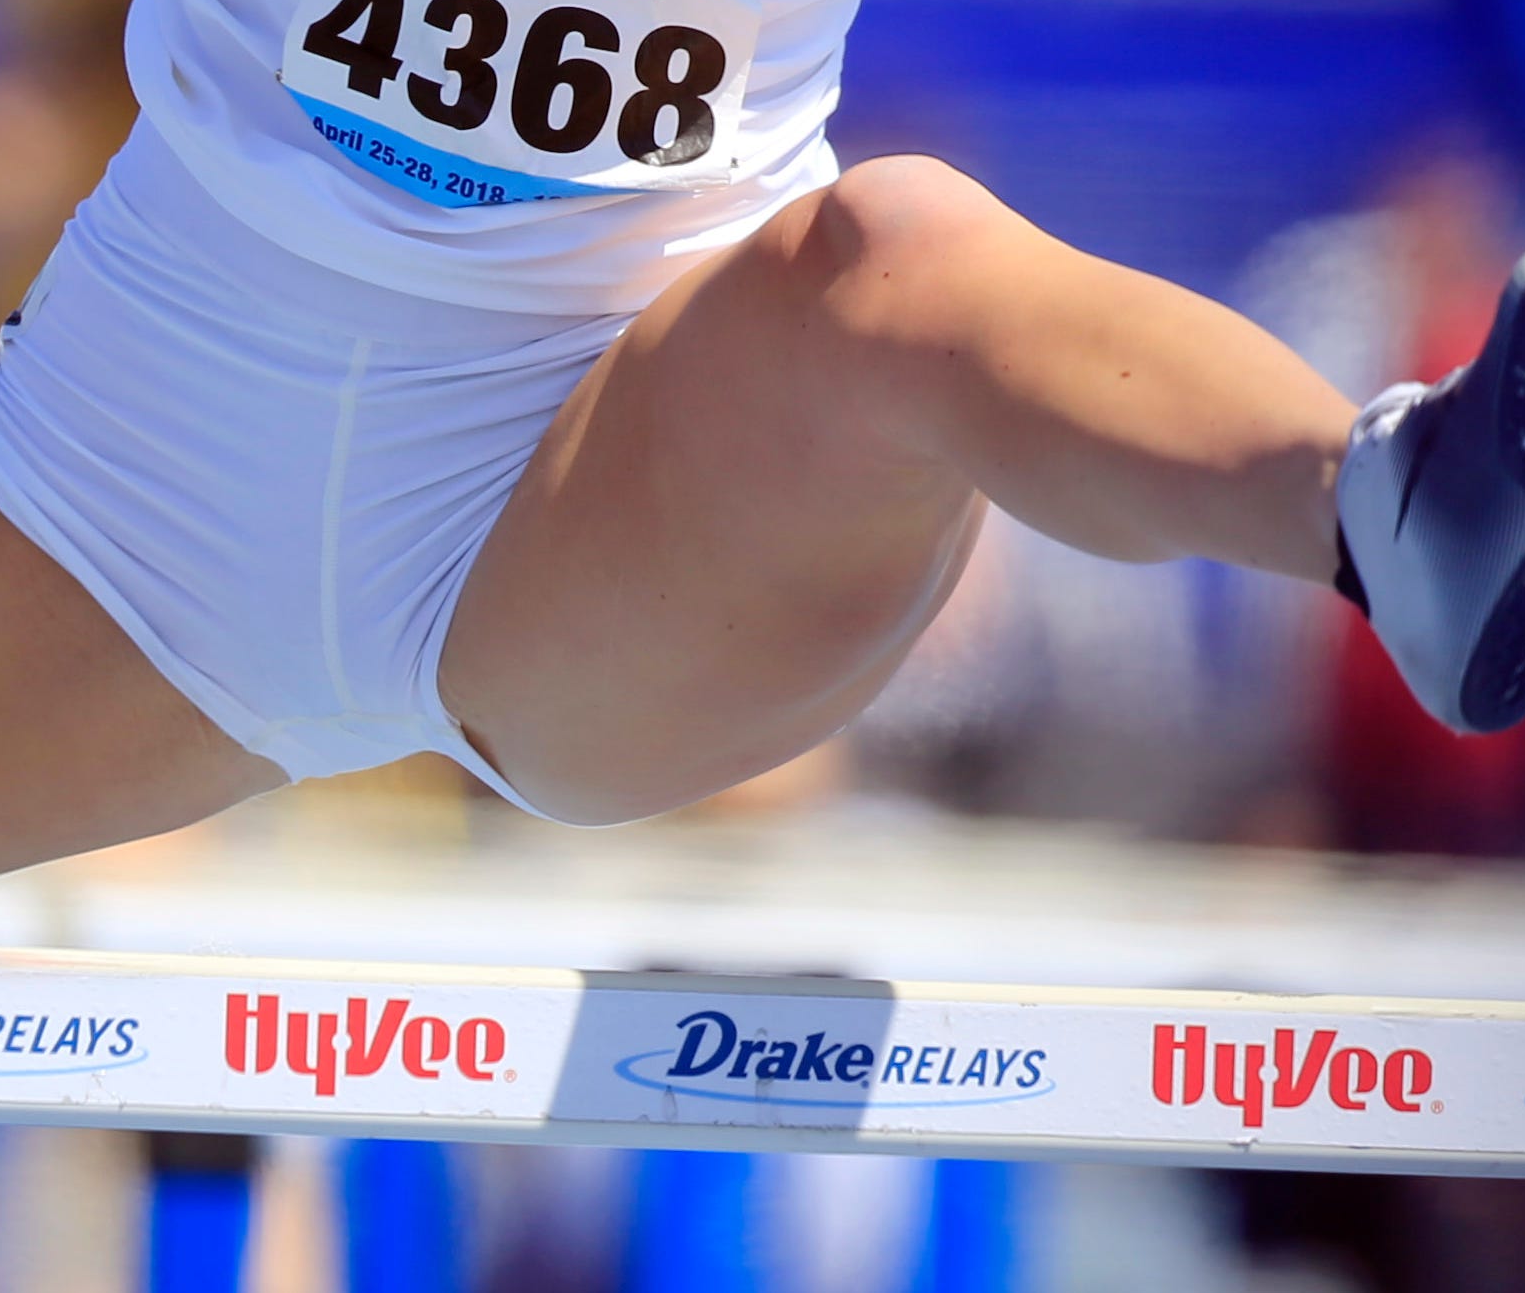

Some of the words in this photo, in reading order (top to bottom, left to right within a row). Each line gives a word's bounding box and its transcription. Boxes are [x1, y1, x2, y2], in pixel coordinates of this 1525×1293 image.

[313, 115, 363, 152] April
[369, 140, 438, 189] 25-28,
[445, 172, 505, 203] 2018
[225, 993, 506, 1096] HyVee
[666, 1010, 874, 1082] Drake
[880, 1044, 1046, 1088] RELAYS
[1152, 1024, 1433, 1128] HyVee
